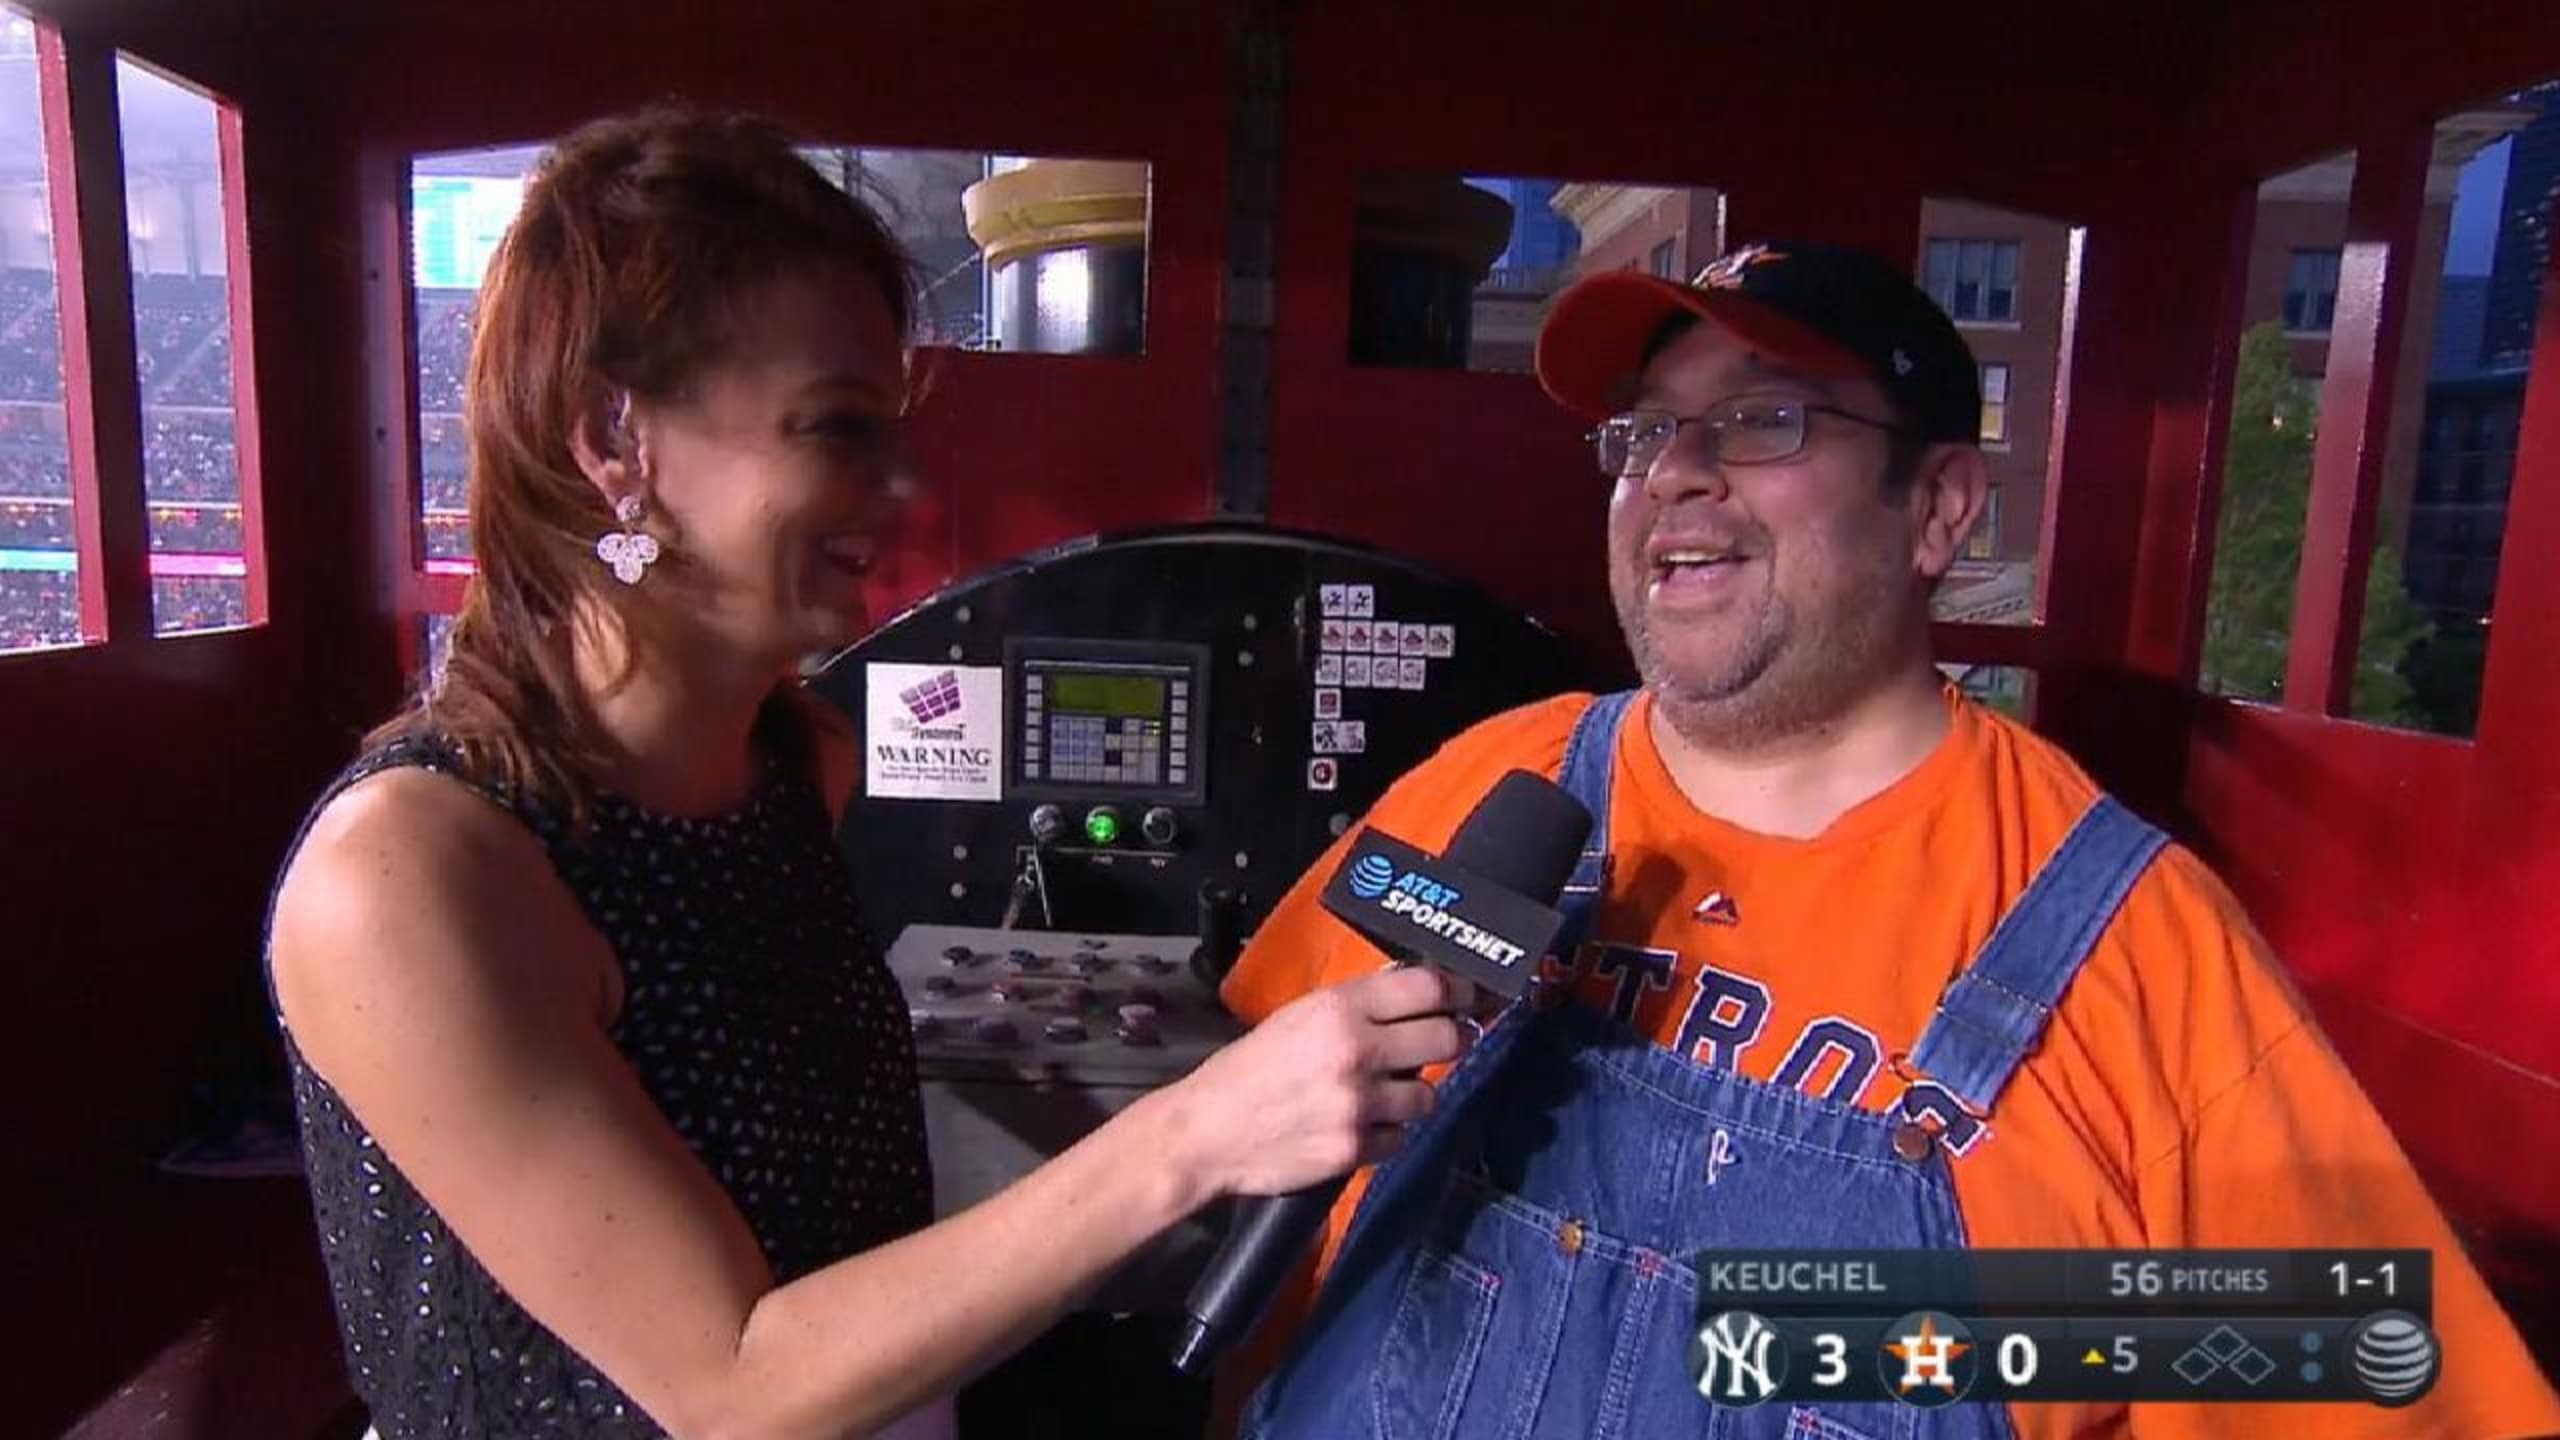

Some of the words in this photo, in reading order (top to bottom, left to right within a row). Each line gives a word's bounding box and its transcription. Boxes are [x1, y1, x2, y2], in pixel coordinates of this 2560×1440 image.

[877, 744, 992, 767] WARNING
[1394, 871, 1460, 908] AT&T
[1381, 889, 1526, 968] SPORTSNET
